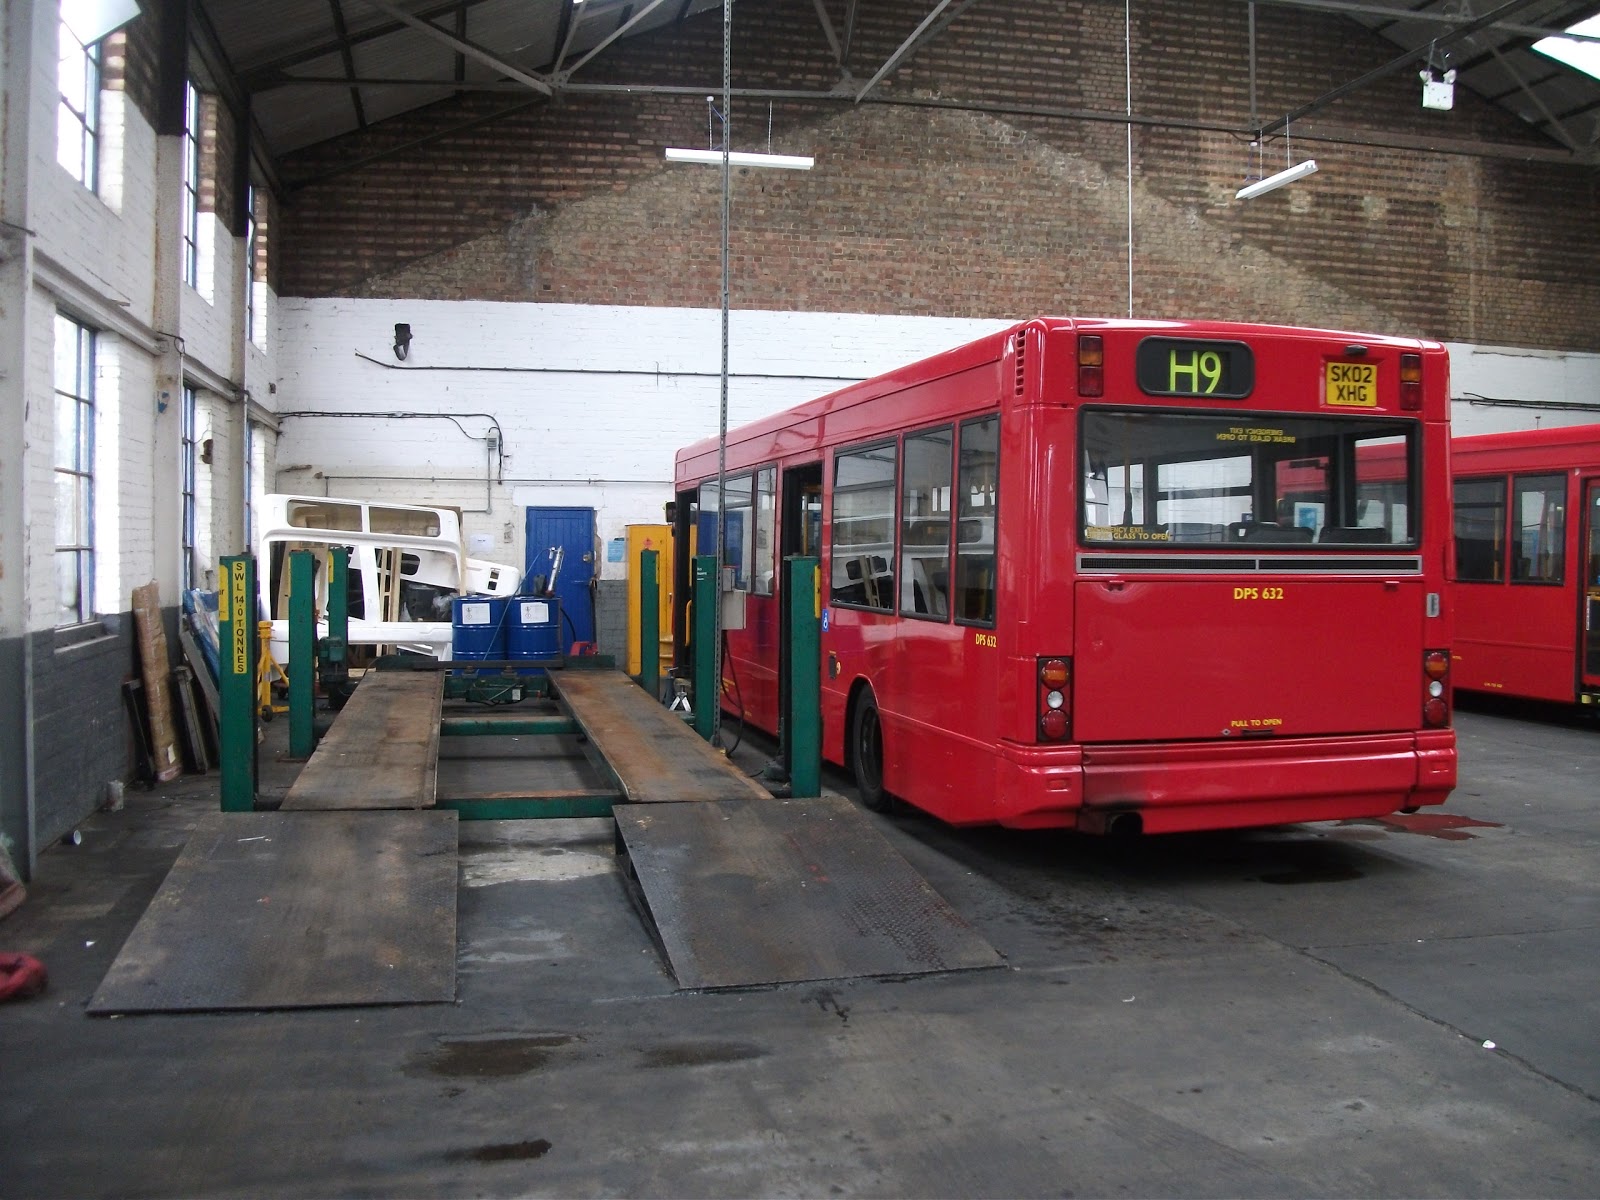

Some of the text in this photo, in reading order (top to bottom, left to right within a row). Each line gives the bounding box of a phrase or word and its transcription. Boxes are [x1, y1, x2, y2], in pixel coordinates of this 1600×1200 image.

[1169, 350, 1222, 394] H9
[1331, 366, 1372, 383] SK02
[1336, 385, 1367, 401] XHG
[234, 562, 245, 591] SWL
[1234, 587, 1284, 600] DPS 632
[236, 619, 244, 672] TONNES
[975, 633, 997, 648] DPS 632
[1263, 718, 1282, 726] OPEN
